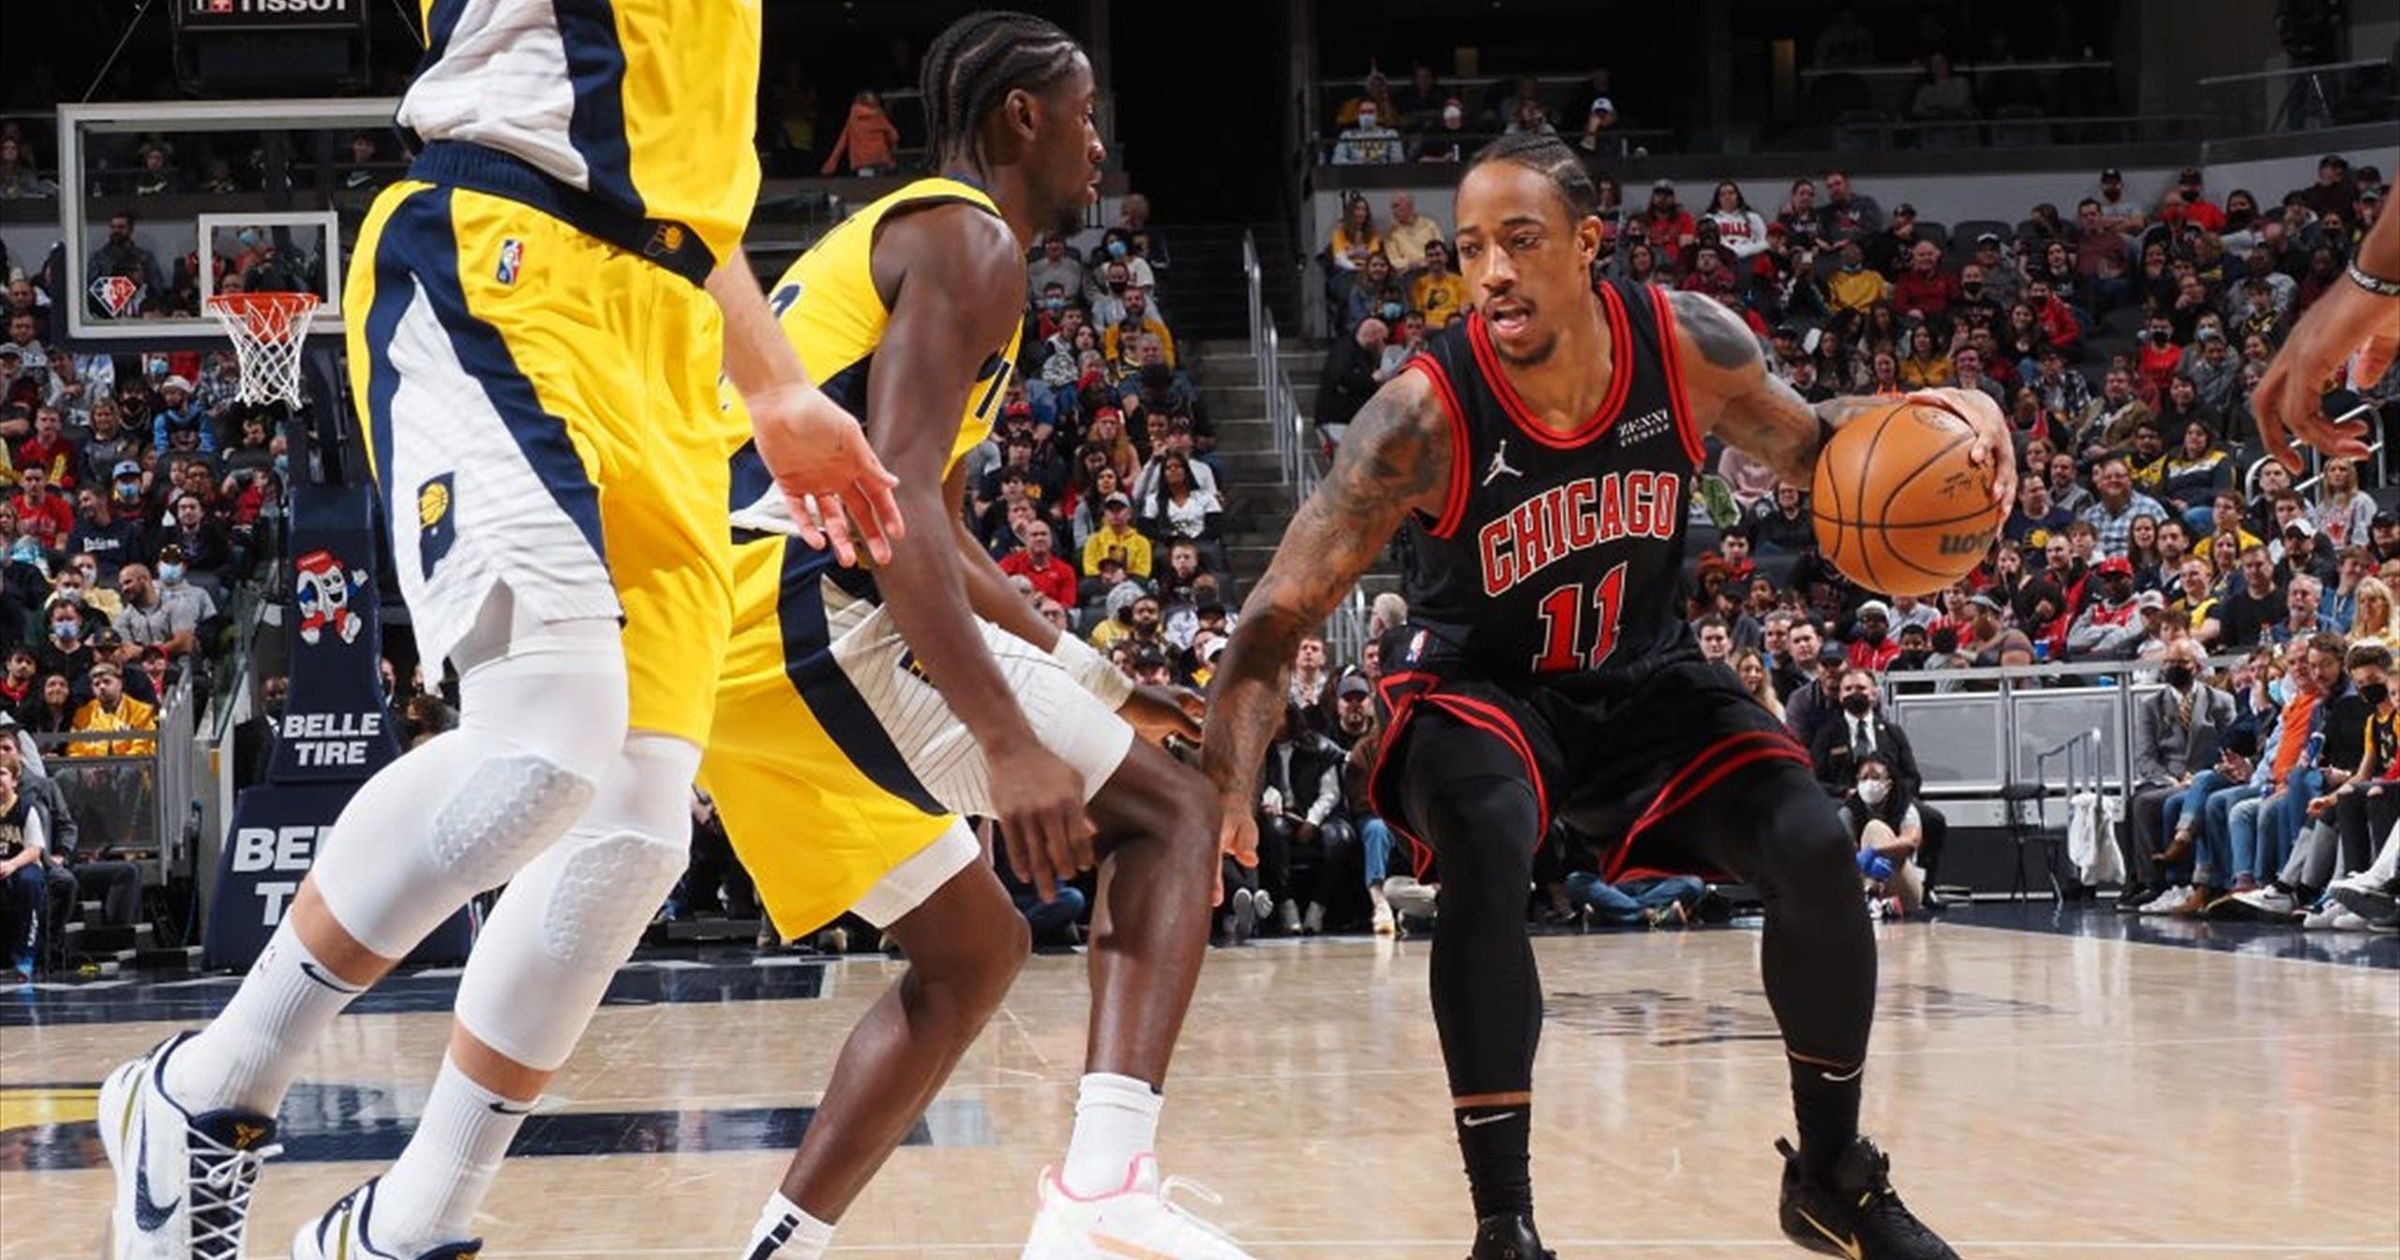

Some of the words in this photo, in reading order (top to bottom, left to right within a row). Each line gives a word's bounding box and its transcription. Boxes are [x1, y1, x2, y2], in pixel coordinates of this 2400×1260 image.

[1478, 470, 1680, 597] CHICAGO
[1532, 561, 1628, 673] 11
[283, 713, 382, 739] BELLE
[294, 740, 368, 766] TIRE
